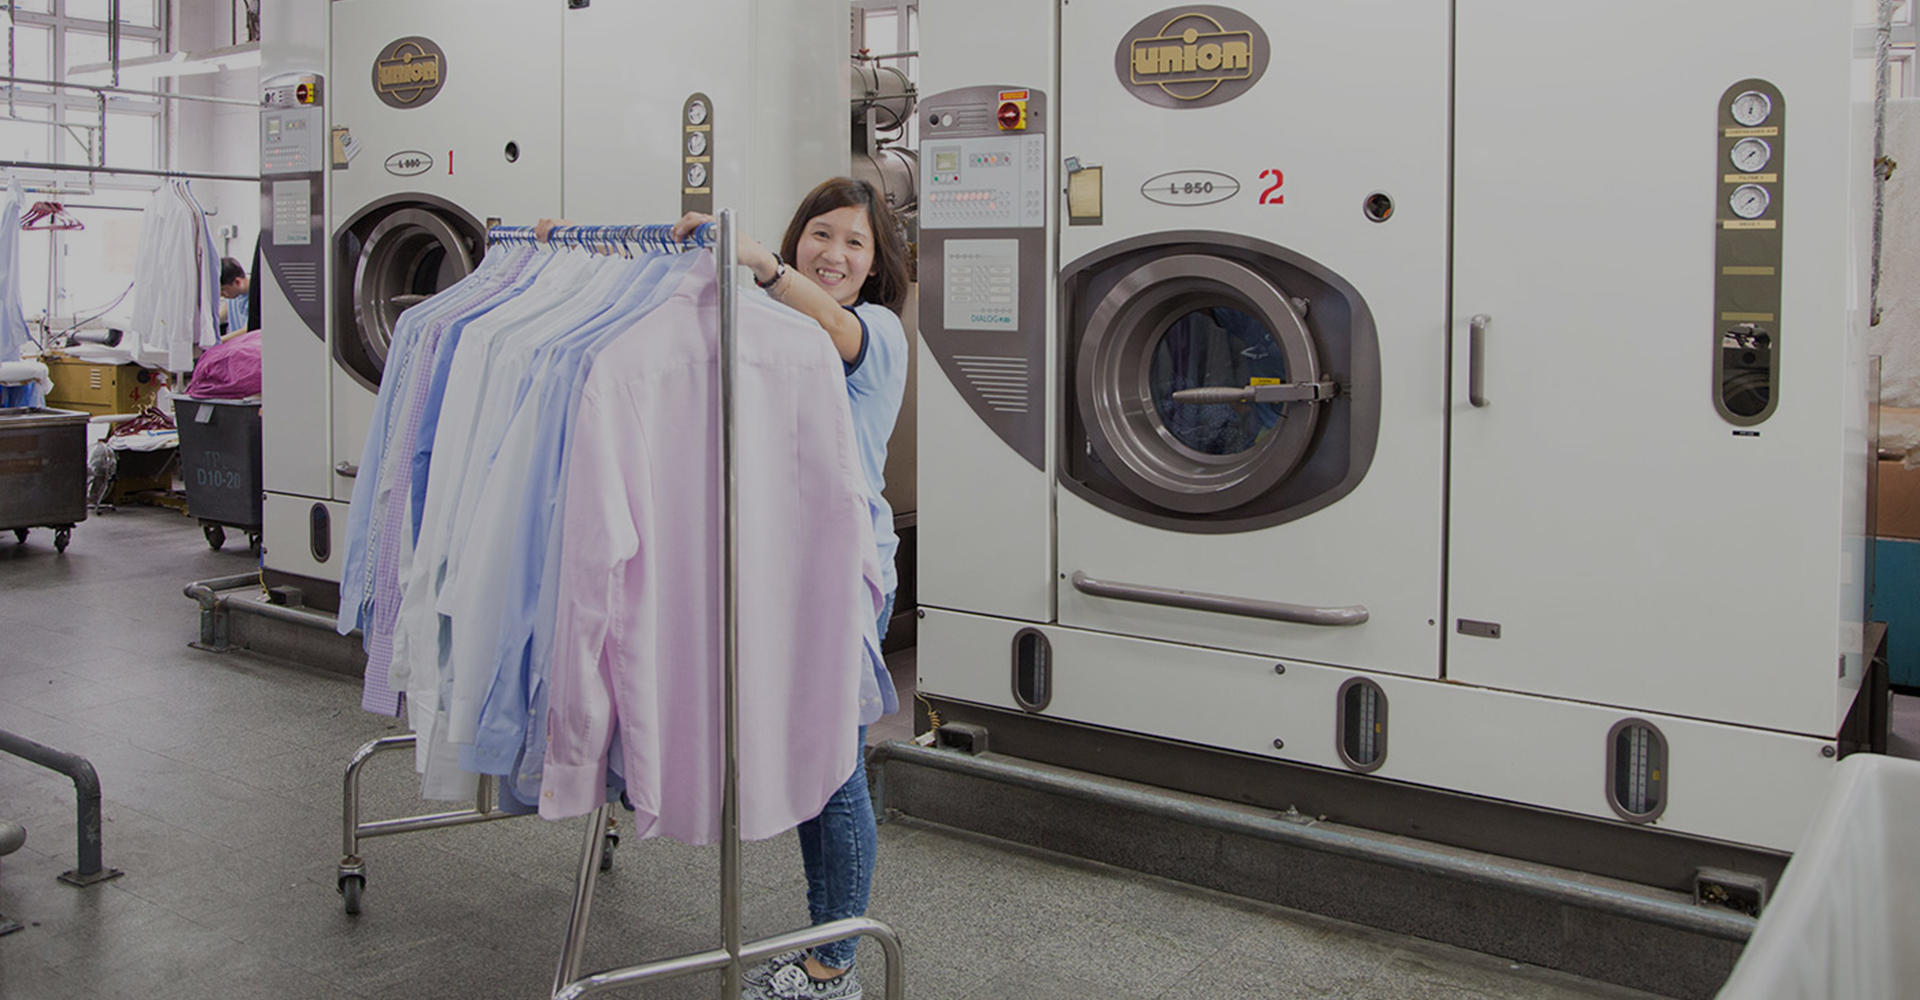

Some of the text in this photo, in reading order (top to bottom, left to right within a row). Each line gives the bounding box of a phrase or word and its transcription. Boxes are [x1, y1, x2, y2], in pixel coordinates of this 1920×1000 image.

[1135, 28, 1248, 75] union
[1170, 181, 1213, 195] L 850
[1258, 169, 1284, 205] 2
[197, 468, 241, 489] D10-20
